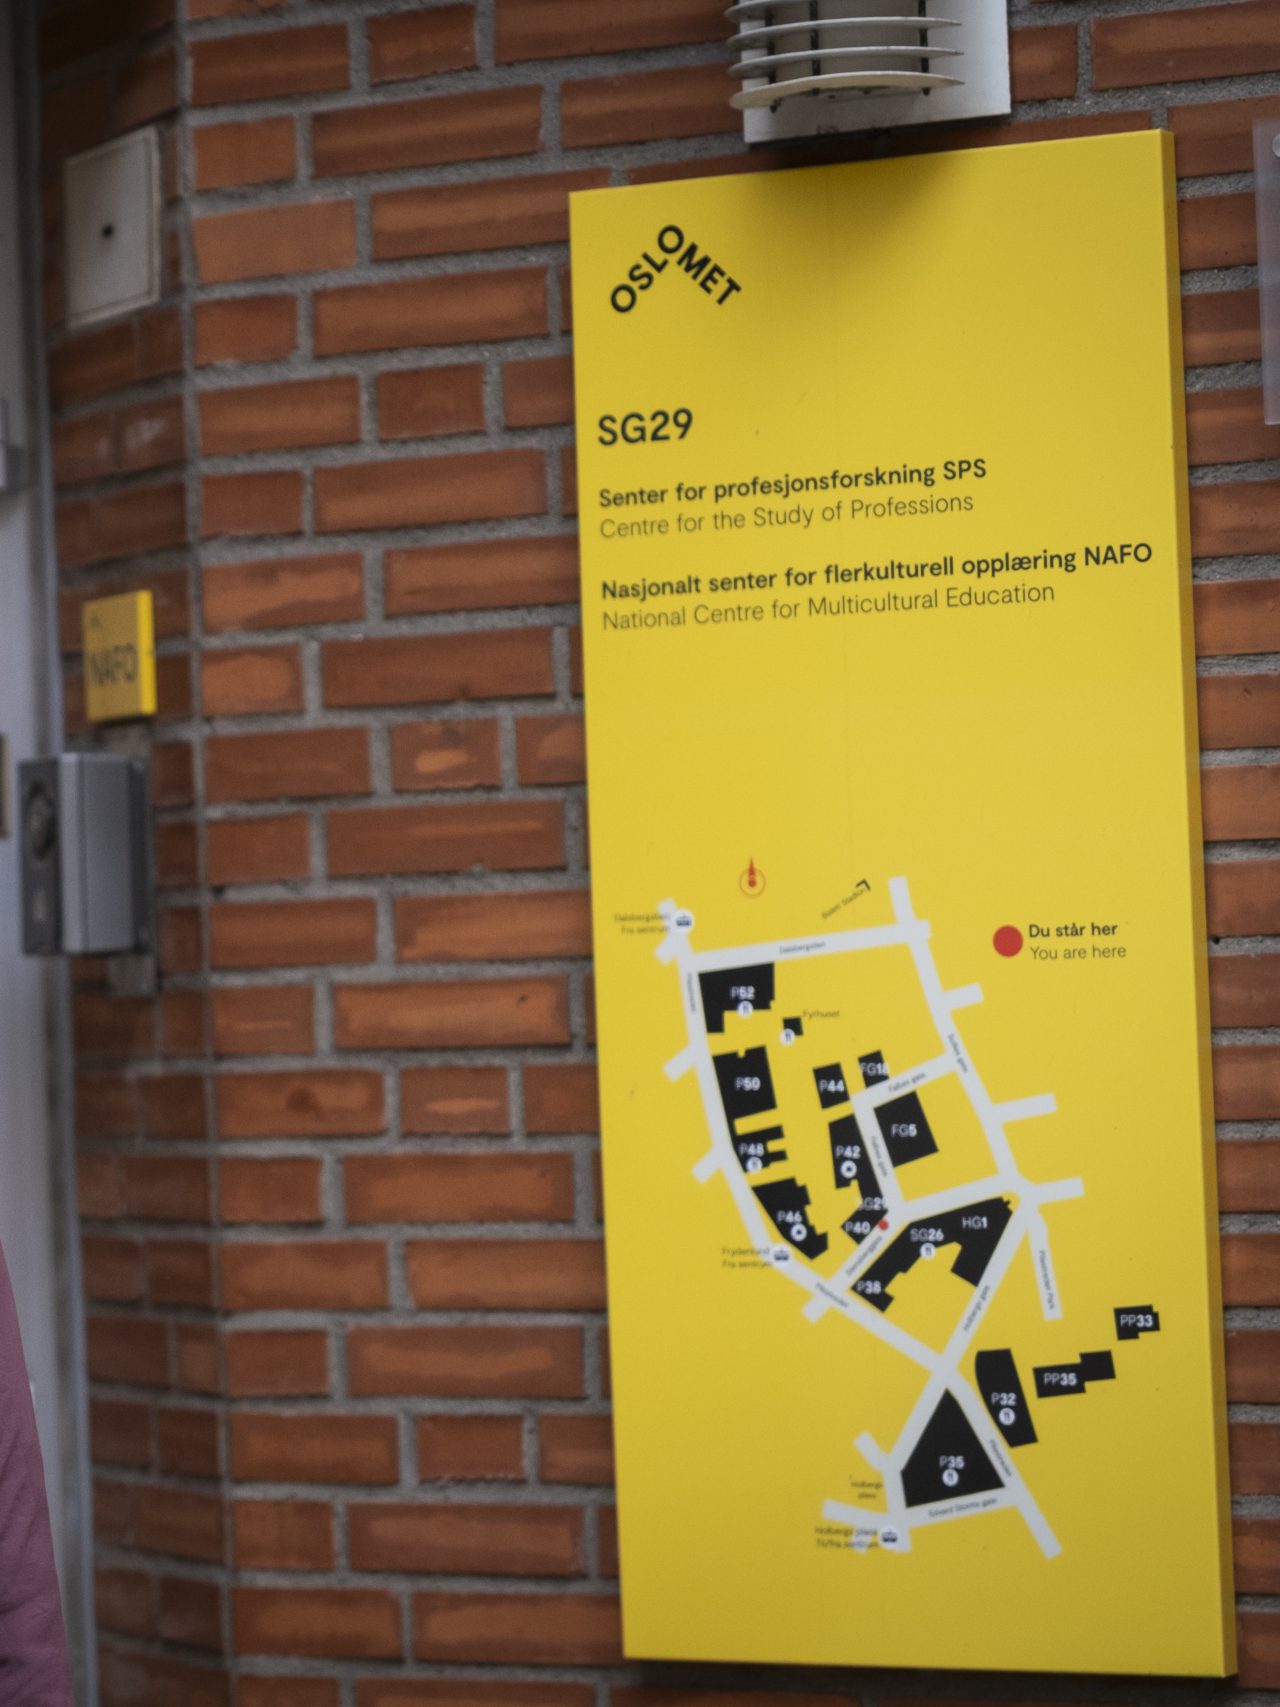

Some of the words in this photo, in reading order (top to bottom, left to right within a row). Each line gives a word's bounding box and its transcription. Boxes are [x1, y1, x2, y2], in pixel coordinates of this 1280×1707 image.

[610, 224, 742, 314] OSLOMET
[598, 407, 693, 446] SG29
[599, 487, 668, 507] Senter
[675, 482, 707, 501] for
[714, 464, 935, 502] profesjonsforskning
[943, 458, 986, 480] SPS
[600, 518, 669, 538] Centre
[677, 513, 704, 533] for
[713, 511, 745, 529] the
[754, 504, 813, 528] Study
[822, 501, 842, 522] of
[851, 494, 973, 519] Professions
[602, 575, 701, 602] Nasjonalt
[709, 572, 777, 592] senter
[785, 567, 817, 586] for
[825, 556, 954, 584] flerkulturell
[962, 549, 1076, 578] opplæring
[1084, 542, 1152, 567] NAFO
[603, 606, 686, 630] National
[694, 604, 763, 624] Centre
[772, 600, 800, 619] for
[809, 588, 938, 616] Multicultural
[946, 583, 1055, 608] Education
[1028, 924, 1050, 938] Du
[1056, 922, 1086, 937] står
[1091, 922, 1118, 936] her
[1030, 946, 1058, 960] You
[1063, 948, 1087, 959] are
[1092, 944, 1126, 958] here
[730, 985, 755, 1000] P52
[735, 1076, 760, 1091] P50
[820, 1079, 845, 1093] P44
[891, 1124, 917, 1138] FG5
[740, 1143, 764, 1157] P48
[836, 1146, 861, 1159] P42
[777, 1210, 802, 1223] P46
[962, 1216, 988, 1229] HG1
[845, 1221, 870, 1234] P40
[910, 1228, 944, 1242] SG26
[857, 1281, 882, 1294] P38
[1120, 1314, 1153, 1327] PP33
[1044, 1372, 1077, 1386] PP35
[991, 1392, 1016, 1406] P32
[939, 1456, 965, 1469] P35
